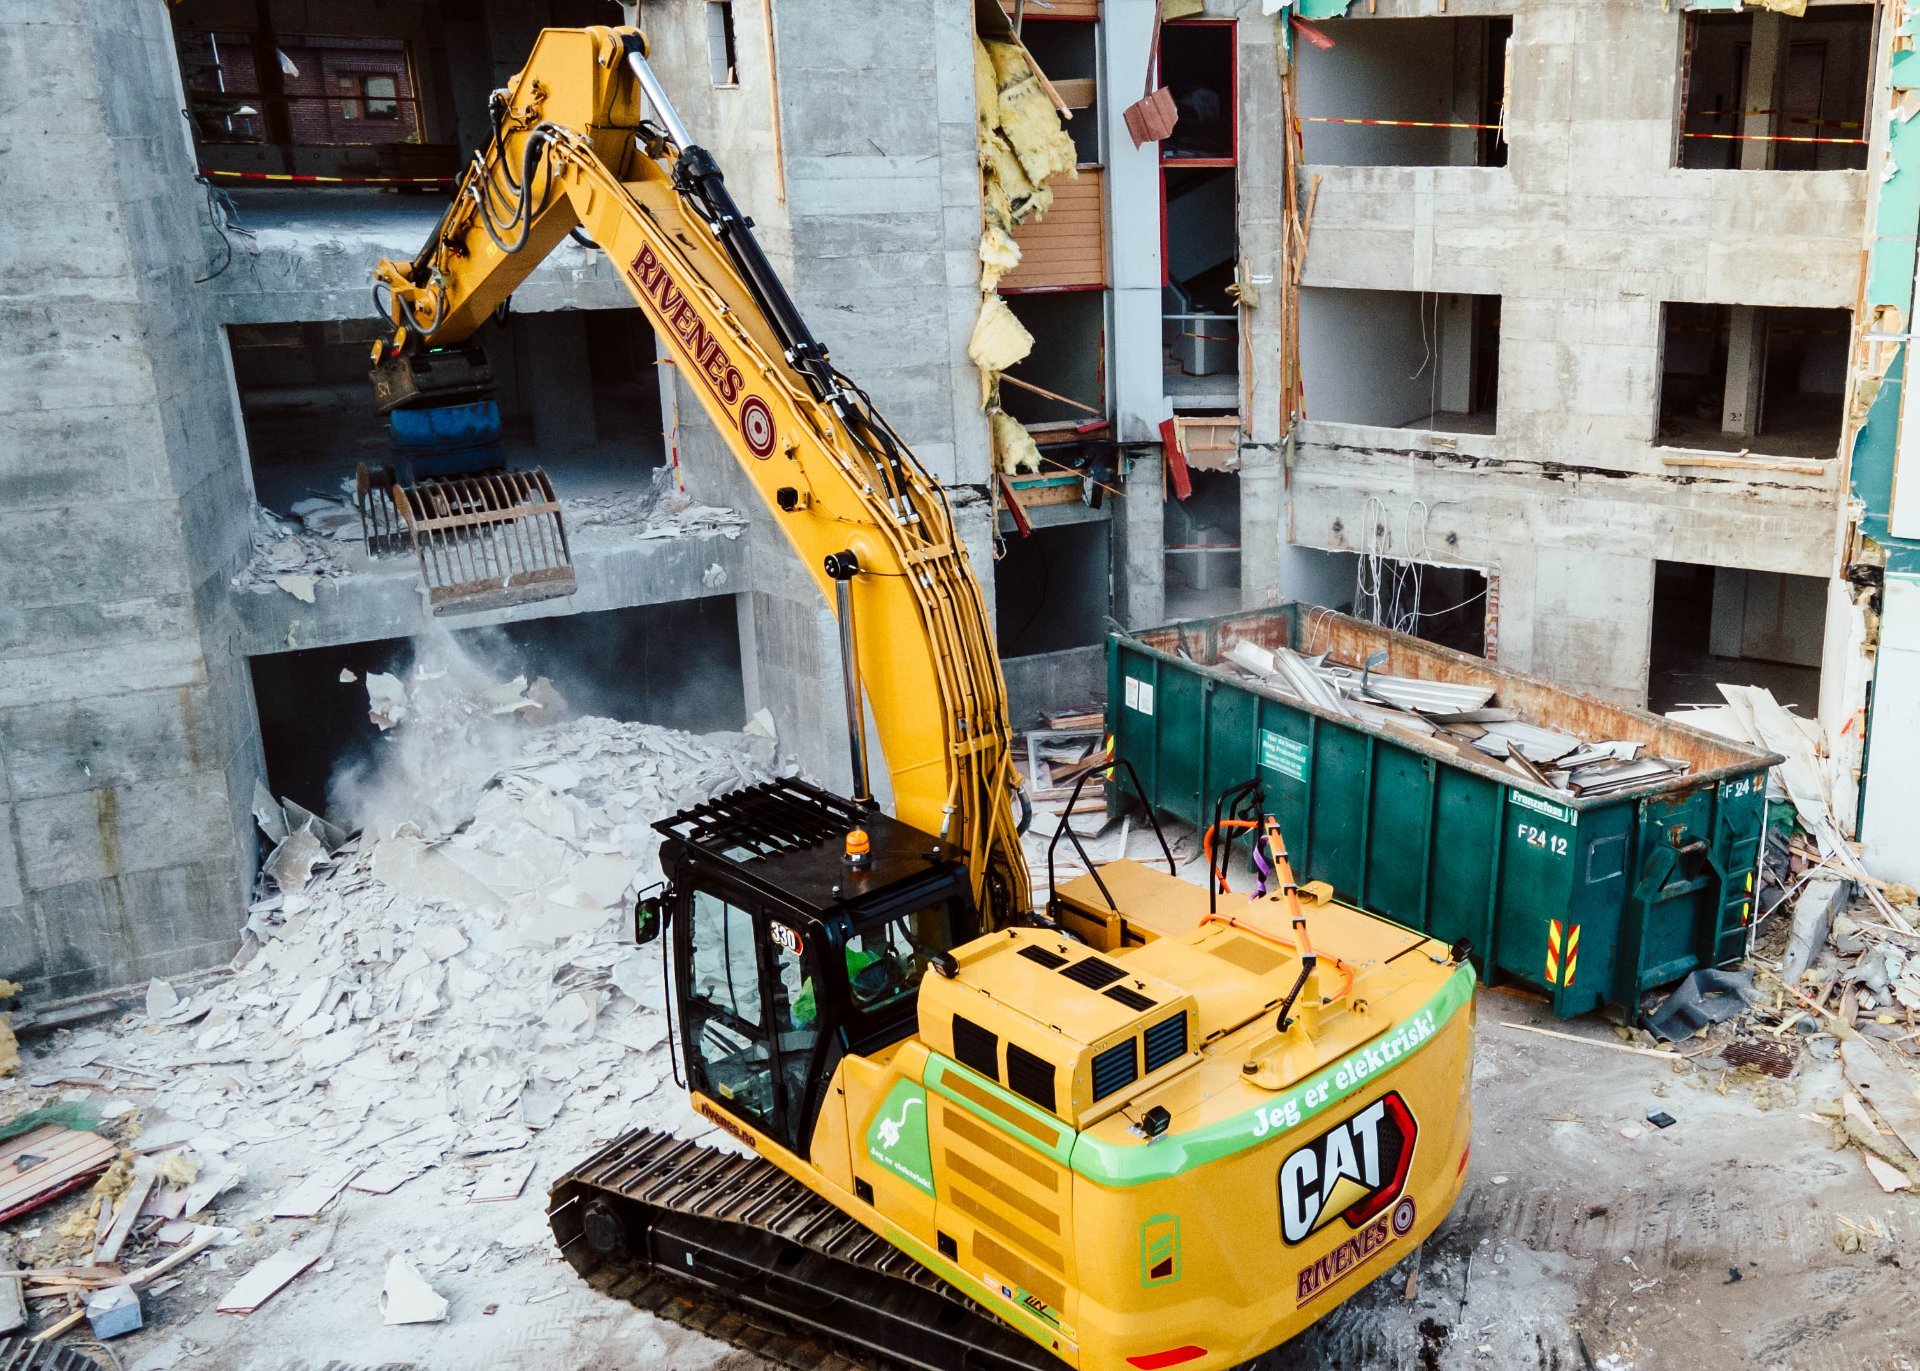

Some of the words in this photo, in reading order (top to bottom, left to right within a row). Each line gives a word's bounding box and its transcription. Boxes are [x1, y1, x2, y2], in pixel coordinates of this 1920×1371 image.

[631, 240, 744, 405] RIVENES
[1512, 790, 1564, 817] Franzefoss
[1550, 835, 1568, 856] 12
[770, 921, 797, 951] 330
[1252, 1097, 1301, 1138] Jeg
[1304, 1082, 1331, 1109] er
[1334, 1009, 1438, 1091] elektrisk!
[1280, 1099, 1385, 1242] CAT
[1296, 1212, 1390, 1300] RIVENES
